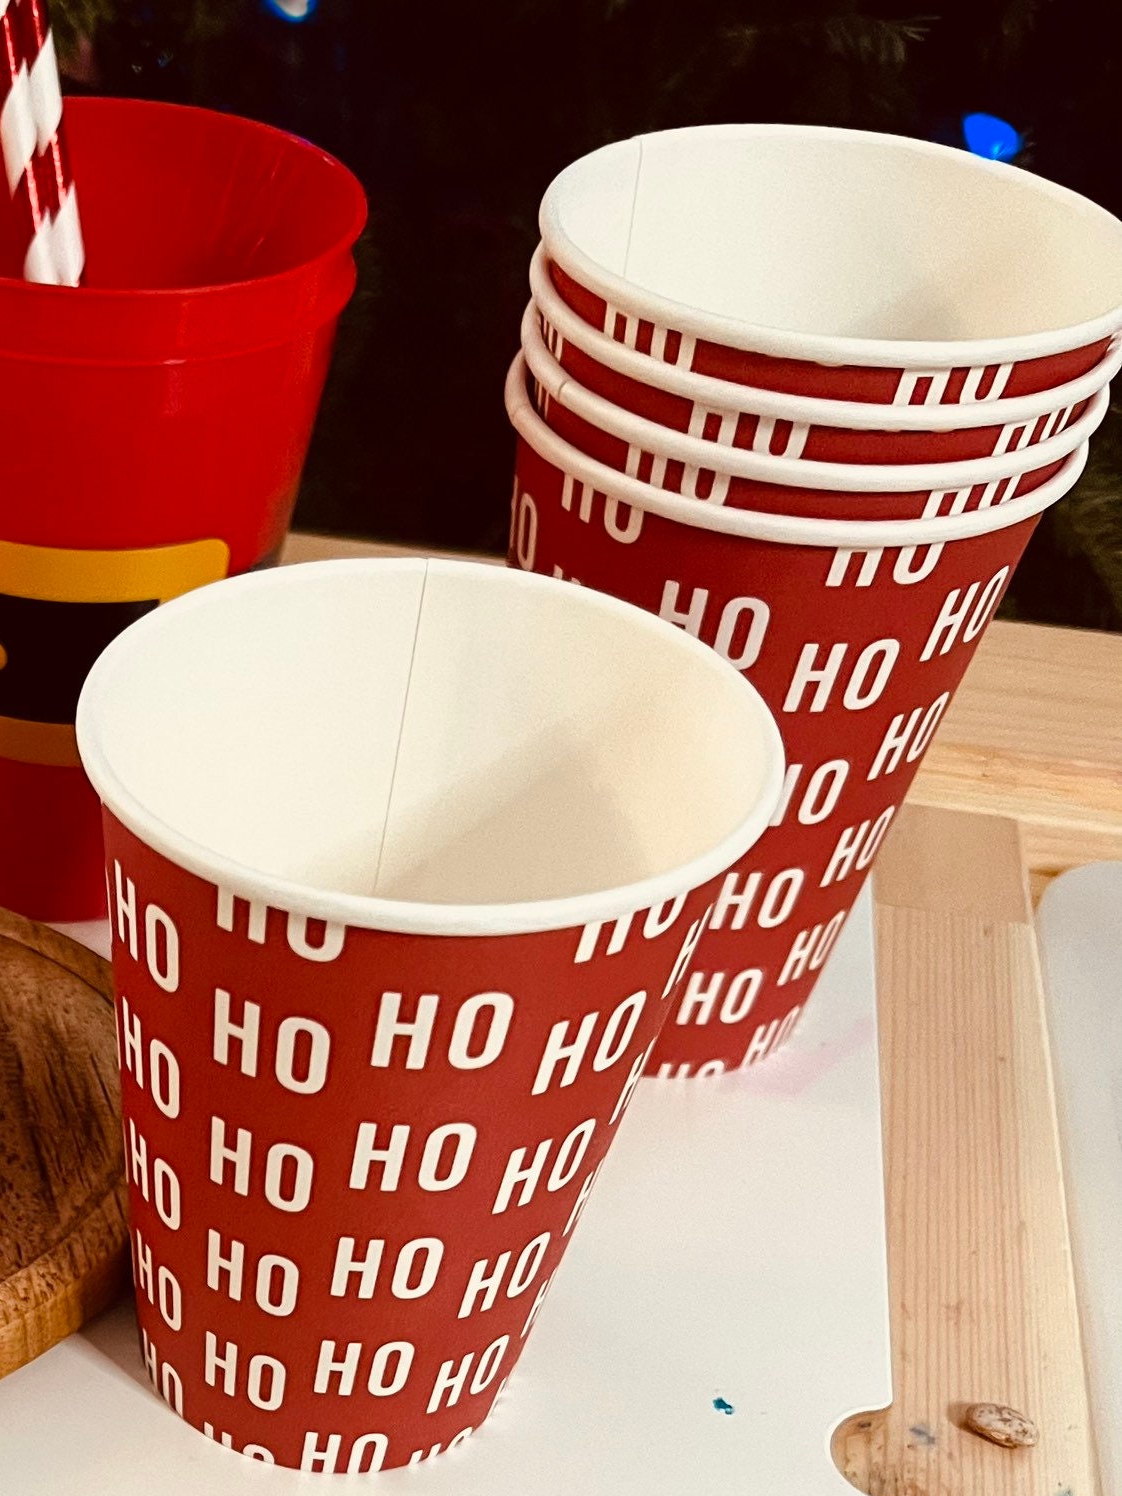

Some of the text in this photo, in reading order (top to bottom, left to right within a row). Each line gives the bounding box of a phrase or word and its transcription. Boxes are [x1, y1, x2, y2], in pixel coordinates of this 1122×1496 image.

[919, 565, 1010, 662] HO
[782, 638, 901, 713] HO
[866, 691, 950, 781] HO
[819, 804, 896, 888] HO
[114, 859, 179, 993] HO
[709, 867, 847, 987] HO HO
[675, 968, 764, 1026] HO
[122, 996, 180, 1119] HO
[213, 988, 331, 1095] HO
[370, 991, 515, 1070] HO
[531, 990, 647, 1096] HO
[129, 1117, 181, 1231] HO
[209, 1115, 314, 1213] HO
[349, 1122, 478, 1192] HO
[491, 1118, 597, 1215] HO
[135, 1229, 182, 1332] HO
[207, 1228, 300, 1317] HO
[330, 1236, 445, 1300] HO
[457, 1231, 551, 1319] HO
[204, 1330, 287, 1412] HO
[313, 1339, 416, 1397] HO
[425, 1334, 511, 1415] HO
[300, 1431, 389, 1474] HO
